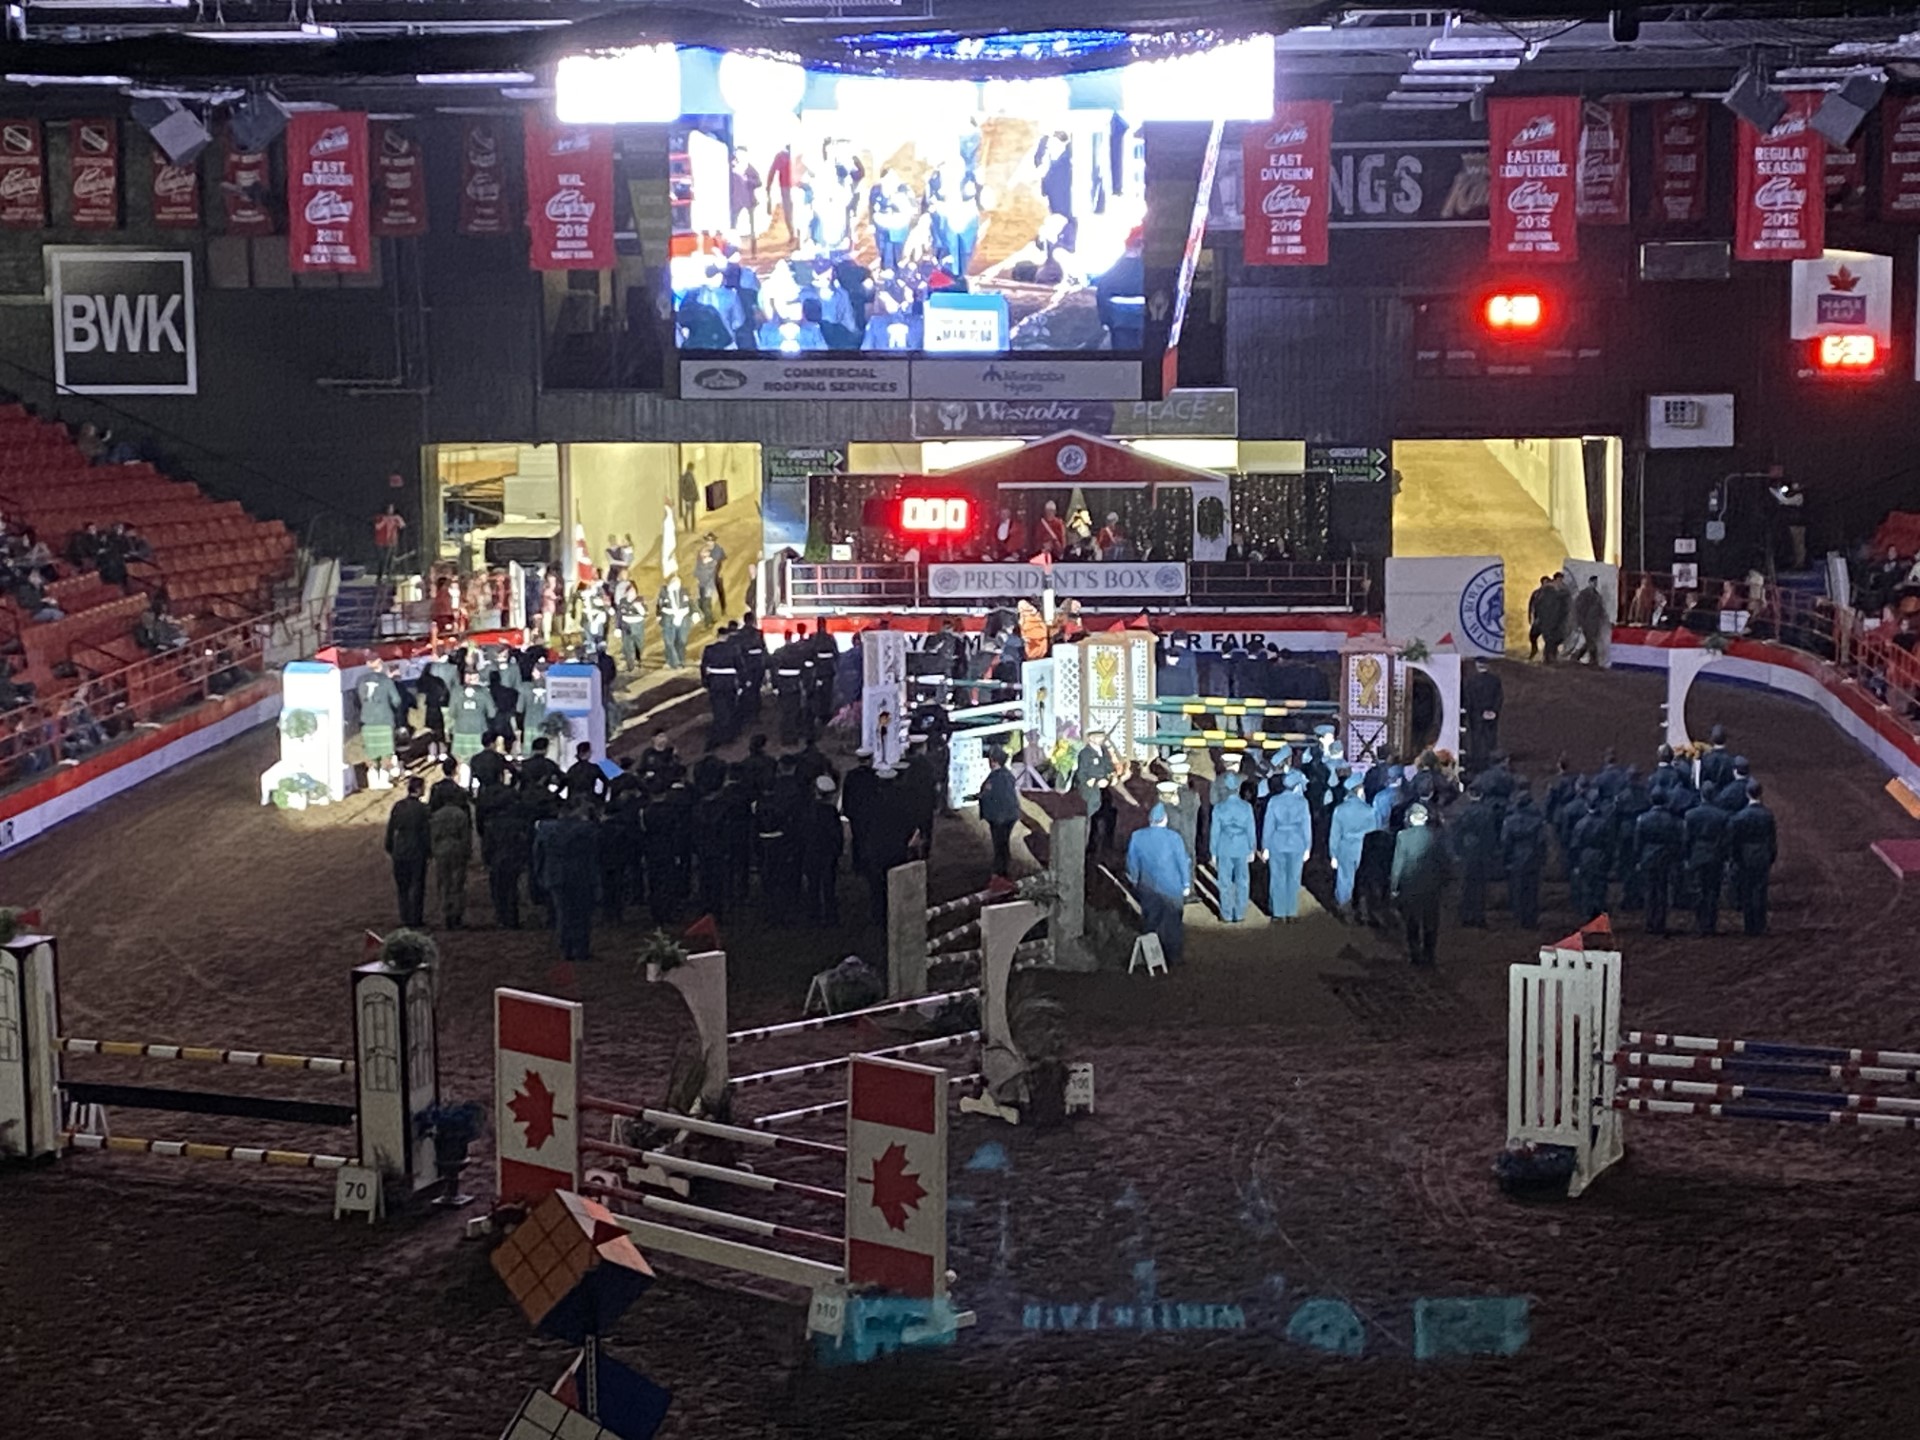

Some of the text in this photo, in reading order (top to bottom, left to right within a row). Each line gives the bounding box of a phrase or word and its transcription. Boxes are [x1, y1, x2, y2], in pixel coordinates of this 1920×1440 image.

[1270, 154, 1303, 166] EAST
[1506, 150, 1560, 163] EASTERN
[1757, 162, 1806, 175] SEASON
[1763, 213, 1799, 226] 2015
[556, 224, 589, 237] 2016
[62, 294, 185, 353] BWK
[783, 367, 877, 379] COMMERCIAL
[763, 381, 898, 393] ROOFING SERVICES
[975, 401, 1081, 421] Westoba
[1104, 569, 1151, 589] BOX
[345, 1181, 367, 1200] 70
